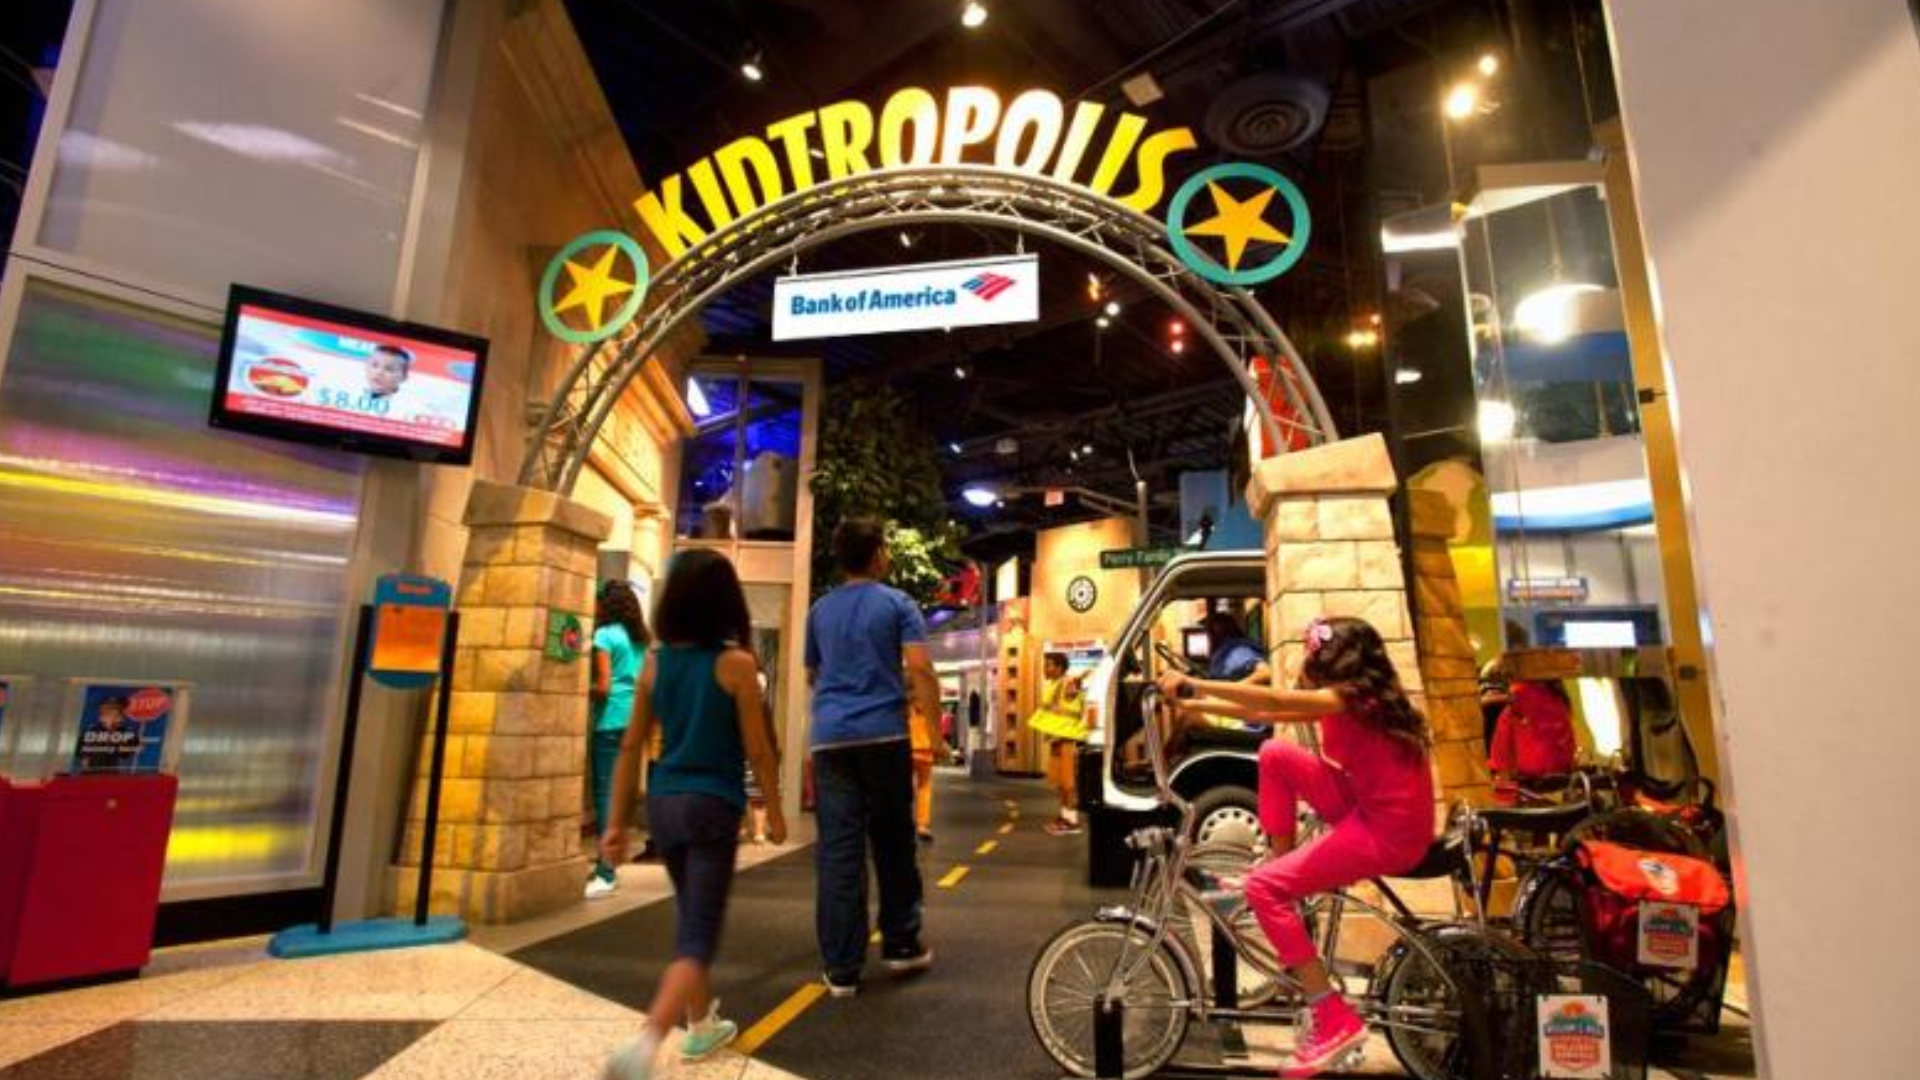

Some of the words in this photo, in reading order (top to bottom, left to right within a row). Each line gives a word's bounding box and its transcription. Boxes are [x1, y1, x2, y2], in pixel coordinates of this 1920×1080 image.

[634, 86, 1196, 262] KIDTROPOLIS
[791, 295, 842, 315] Bank
[845, 290, 866, 312] of
[868, 286, 956, 310] America
[83, 730, 135, 743] DROP
